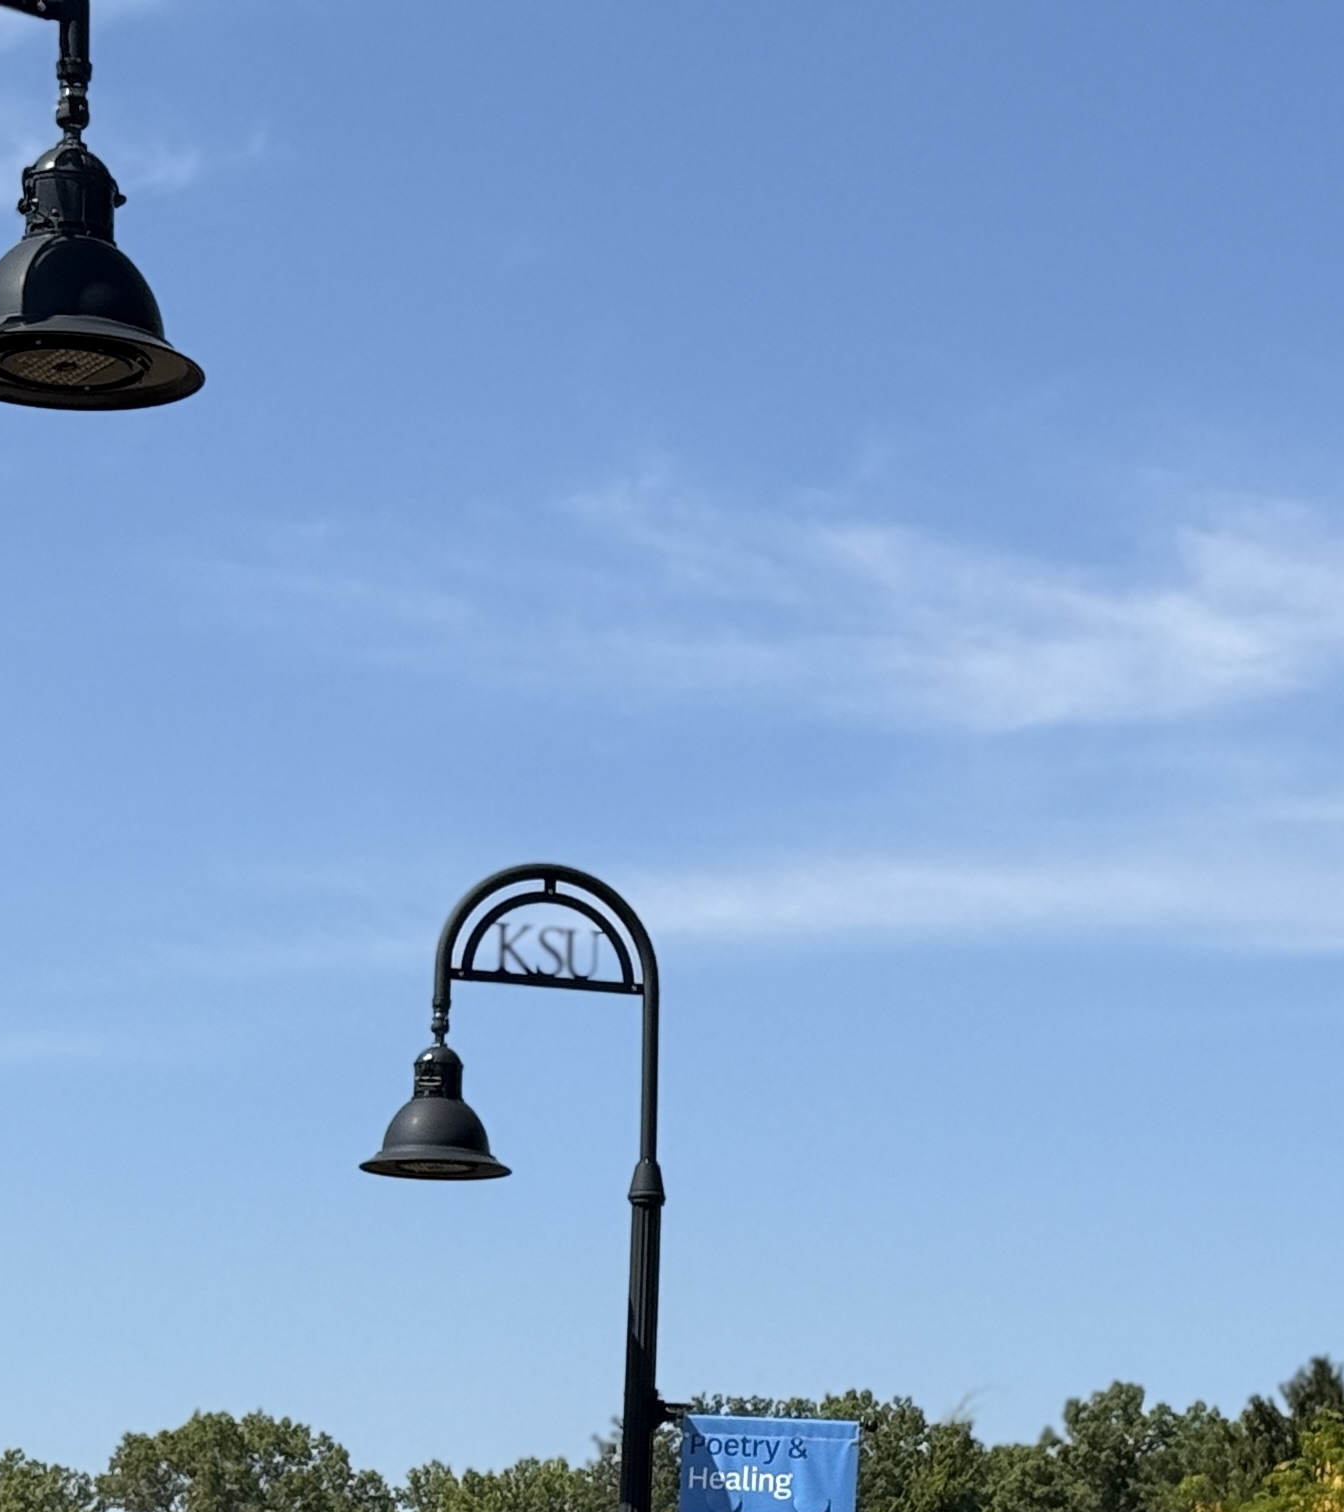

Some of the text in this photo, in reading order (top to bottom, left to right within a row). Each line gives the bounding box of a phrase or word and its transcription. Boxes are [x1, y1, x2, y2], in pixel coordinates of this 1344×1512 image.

[494, 922, 606, 979] KSU
[690, 1435, 808, 1465] Poetry &
[688, 1465, 794, 1500] Healing
